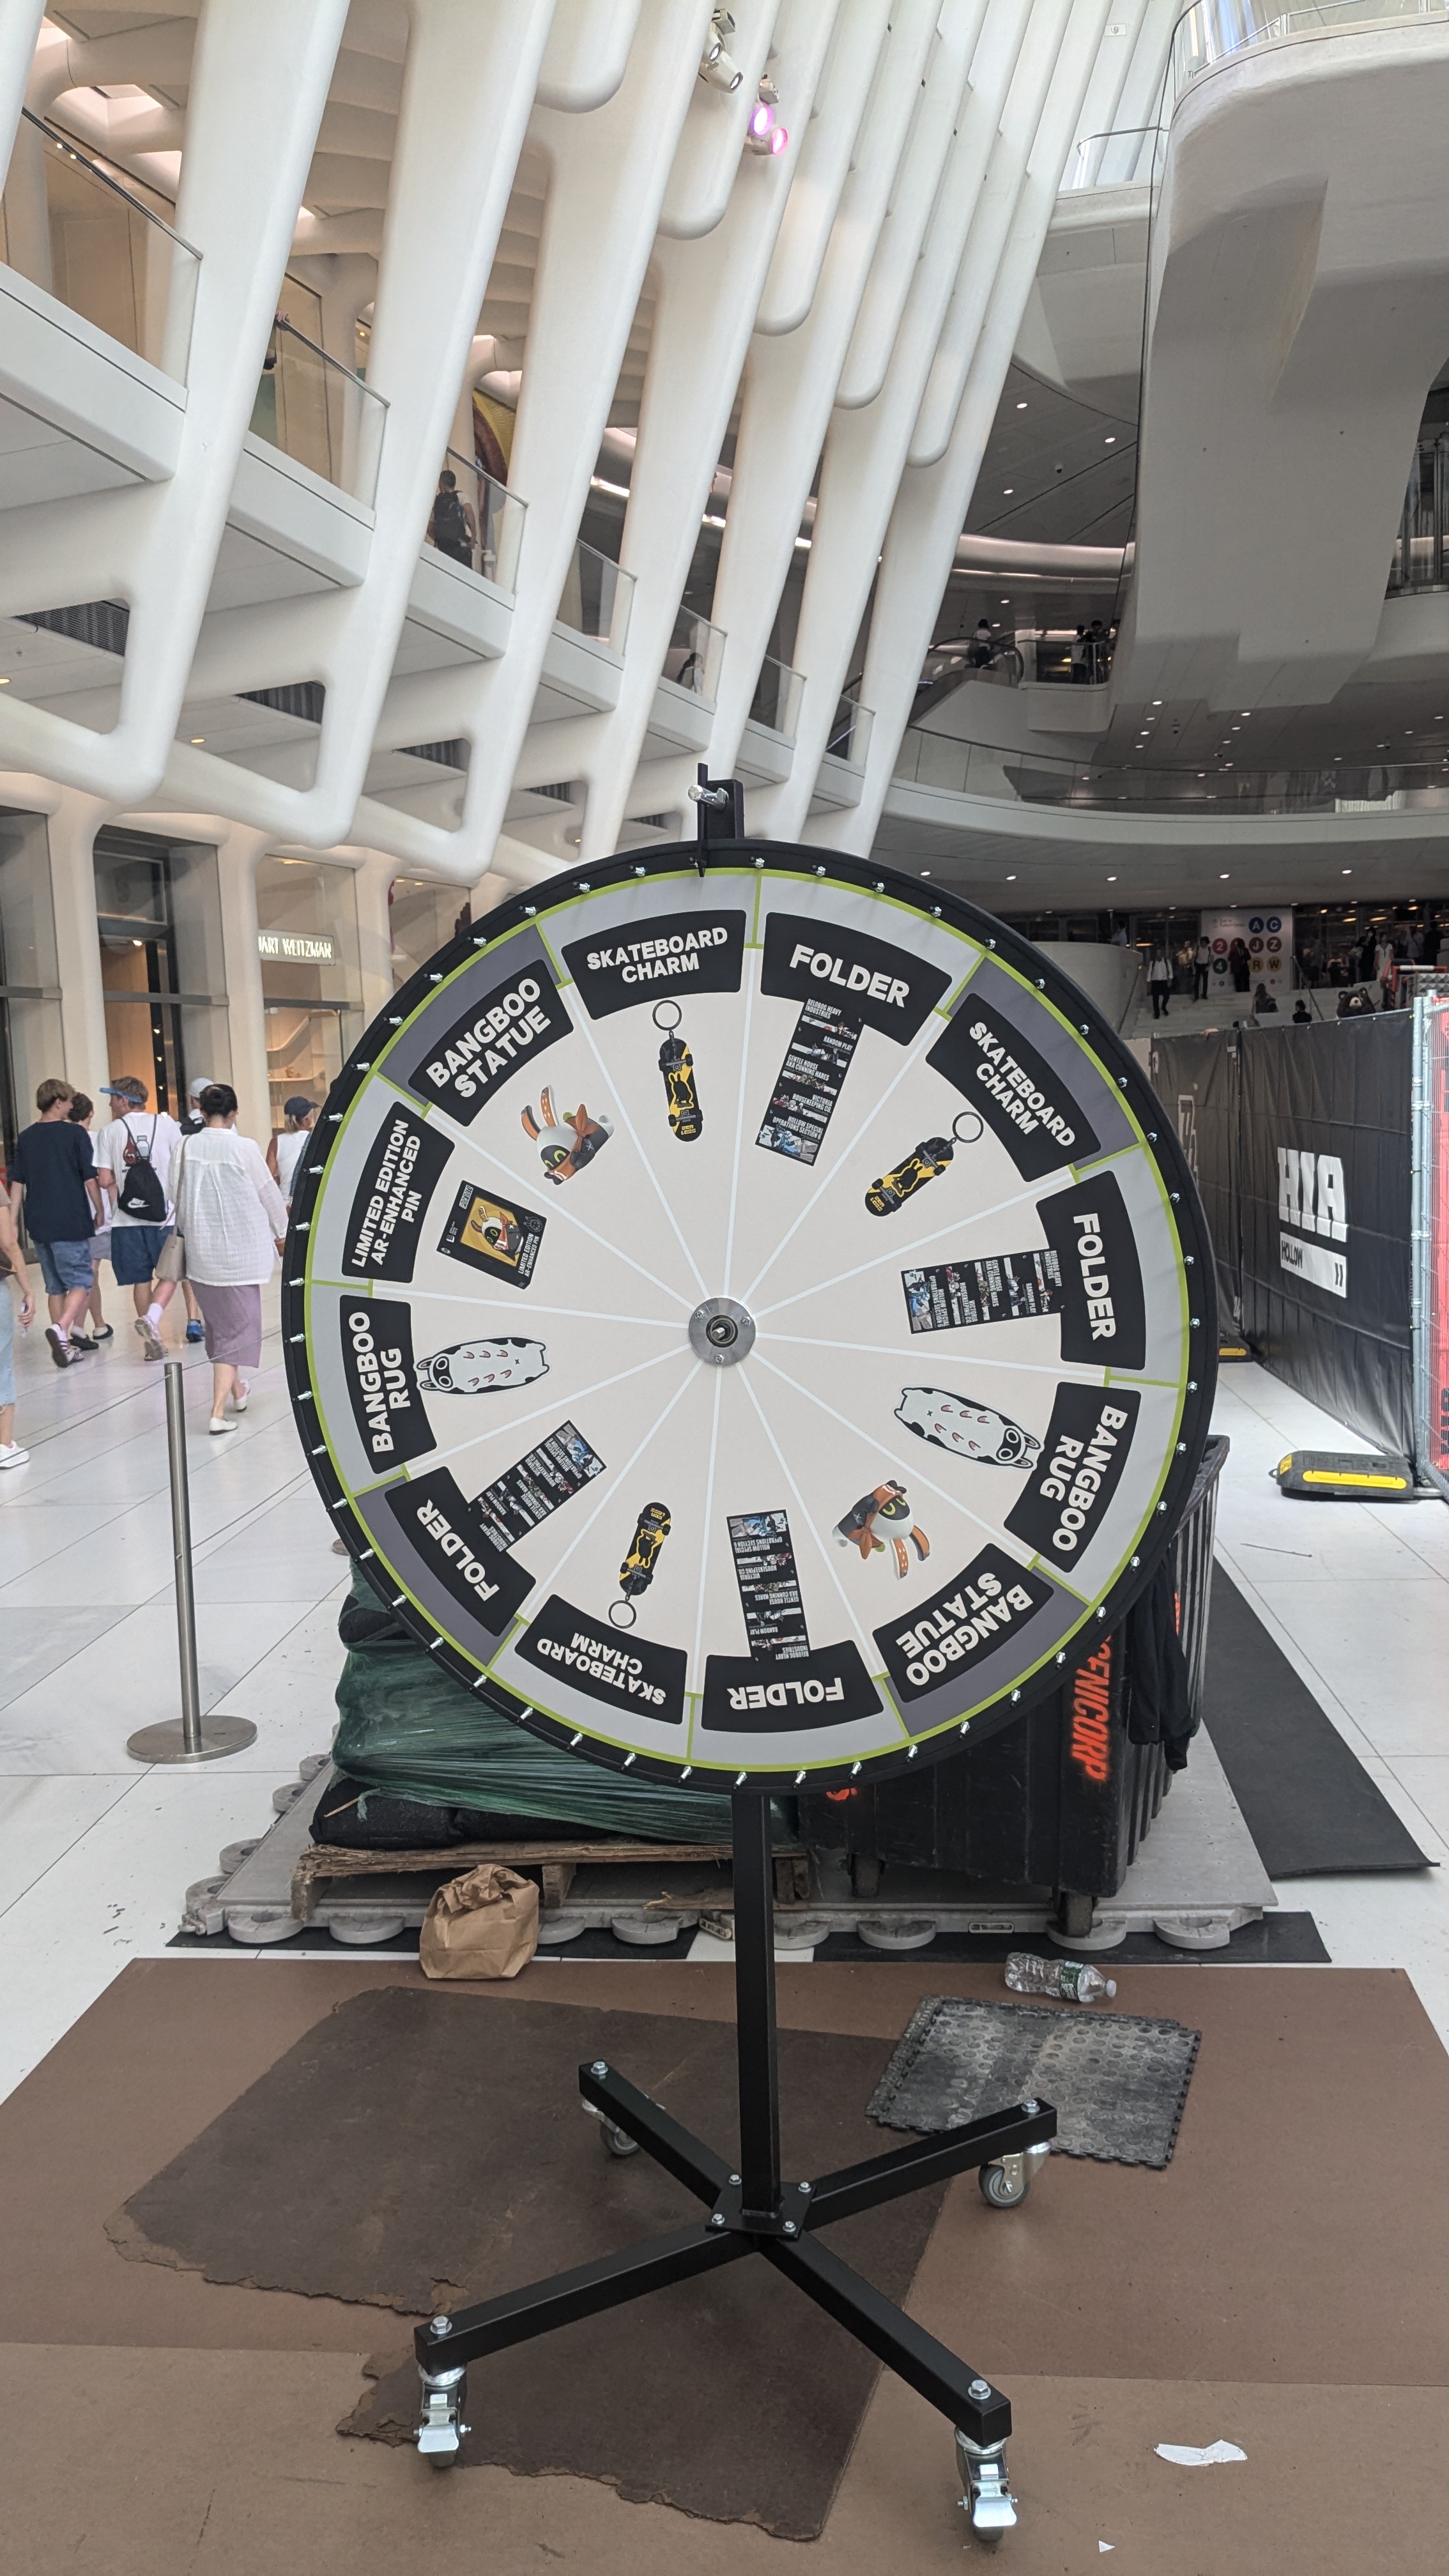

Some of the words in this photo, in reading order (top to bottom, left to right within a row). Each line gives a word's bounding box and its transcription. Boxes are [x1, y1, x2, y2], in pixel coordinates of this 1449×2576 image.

[587, 928, 727, 969] SKATEBOARD
[1216, 941, 1223, 951] 2
[1252, 920, 1260, 930] A
[1269, 921, 1278, 930] C
[1252, 940, 1259, 950] J
[1269, 940, 1278, 949] Z
[622, 953, 699, 983] CHARM
[790, 944, 909, 1008] FOLDER
[1216, 961, 1223, 970] 4
[1253, 960, 1260, 969] R
[1269, 960, 1279, 969] W
[426, 979, 540, 1087] BANGBOO
[455, 1006, 551, 1097] STATUE
[970, 1022, 1075, 1146] SKATEBOARD
[977, 1063, 1039, 1134] CHARM
[352, 1196, 383, 1267] LIMITED
[375, 1119, 408, 1192] EDITION
[371, 1136, 420, 1265] AR-ENHANCED
[401, 1190, 422, 1222] PIN
[517, 1252, 528, 1274] LIMITED
[523, 1232, 534, 1253] EDITION
[1073, 1213, 1116, 1340] FOLDER
[349, 1312, 394, 1452] BANGBOO
[381, 1348, 410, 1409] RUG
[1040, 1435, 1084, 1501] RUG
[1053, 1406, 1128, 1551] BANGBOO
[417, 1499, 500, 1601] FOLDER
[896, 1573, 1001, 1659] STATUE
[907, 1584, 1033, 1685] BANGBOO
[537, 1639, 666, 1705] SKATEBOARD
[571, 1633, 642, 1674] CHARM
[727, 1678, 844, 1710] FOLDER
